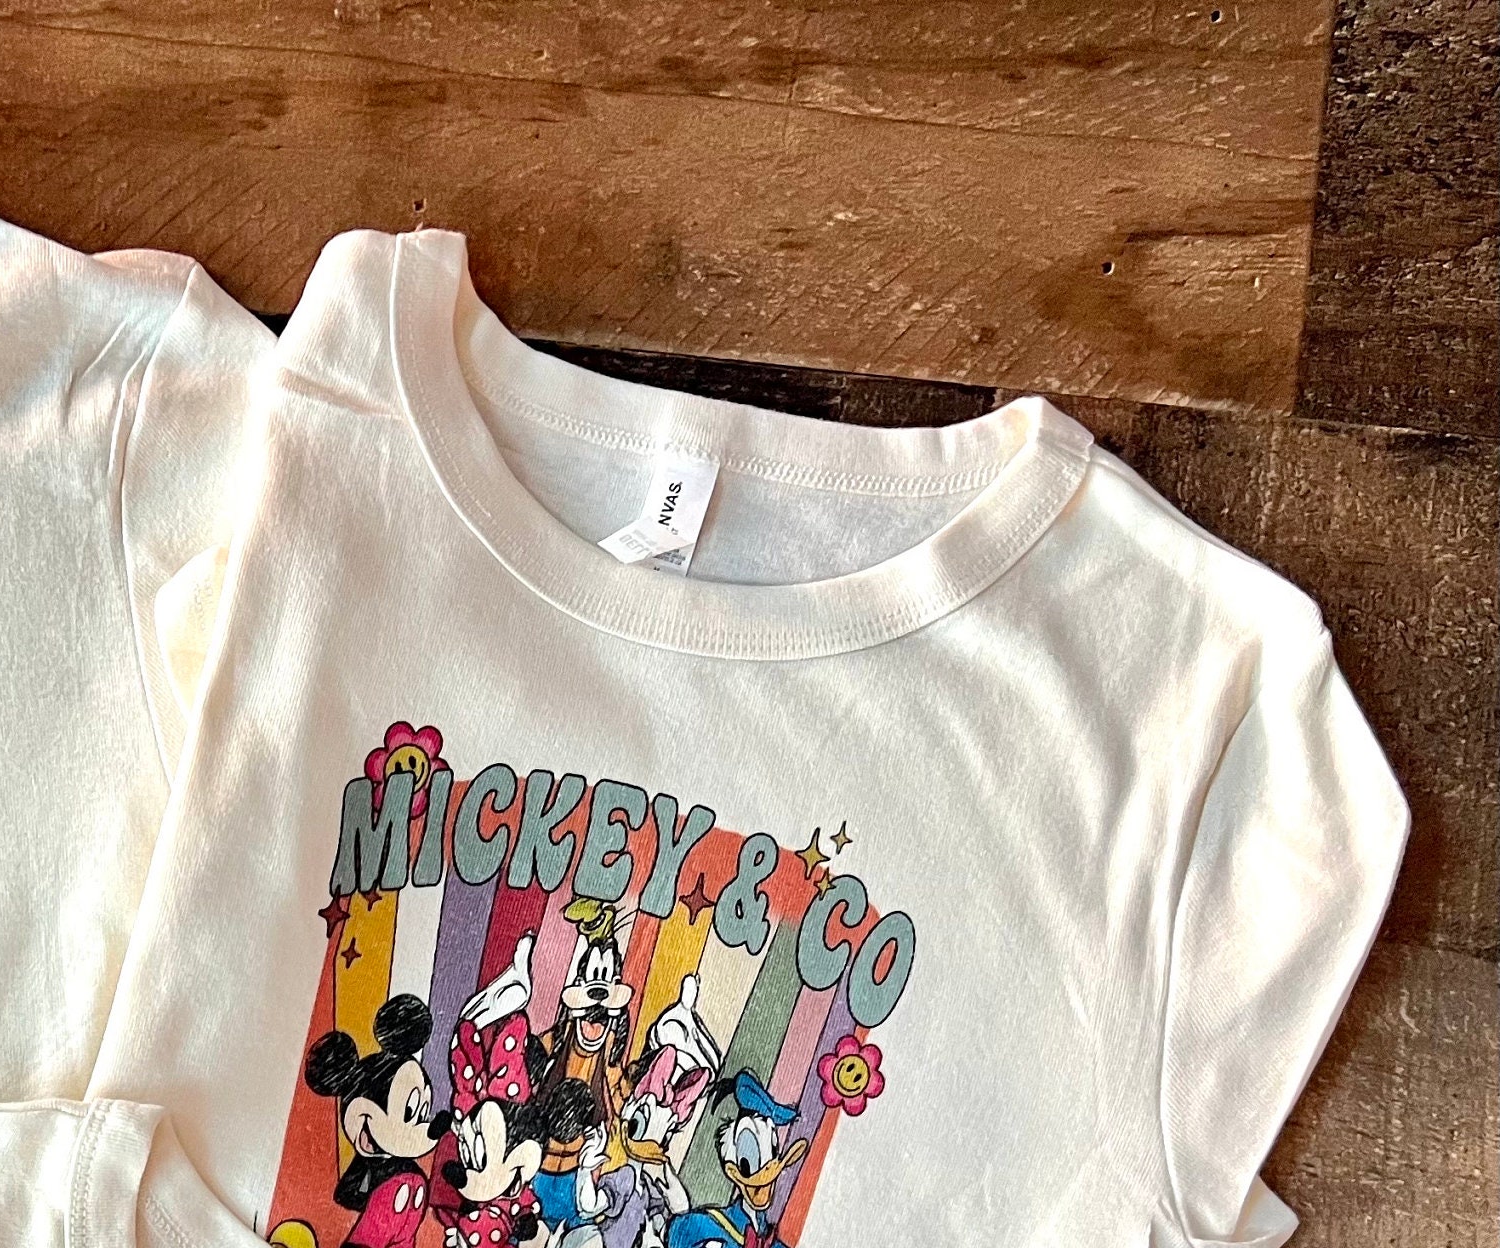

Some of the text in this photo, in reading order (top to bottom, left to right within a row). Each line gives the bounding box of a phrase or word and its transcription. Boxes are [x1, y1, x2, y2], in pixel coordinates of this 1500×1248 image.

[658, 481, 683, 526] NVAS
[330, 763, 917, 1028] MICKEY & CO
